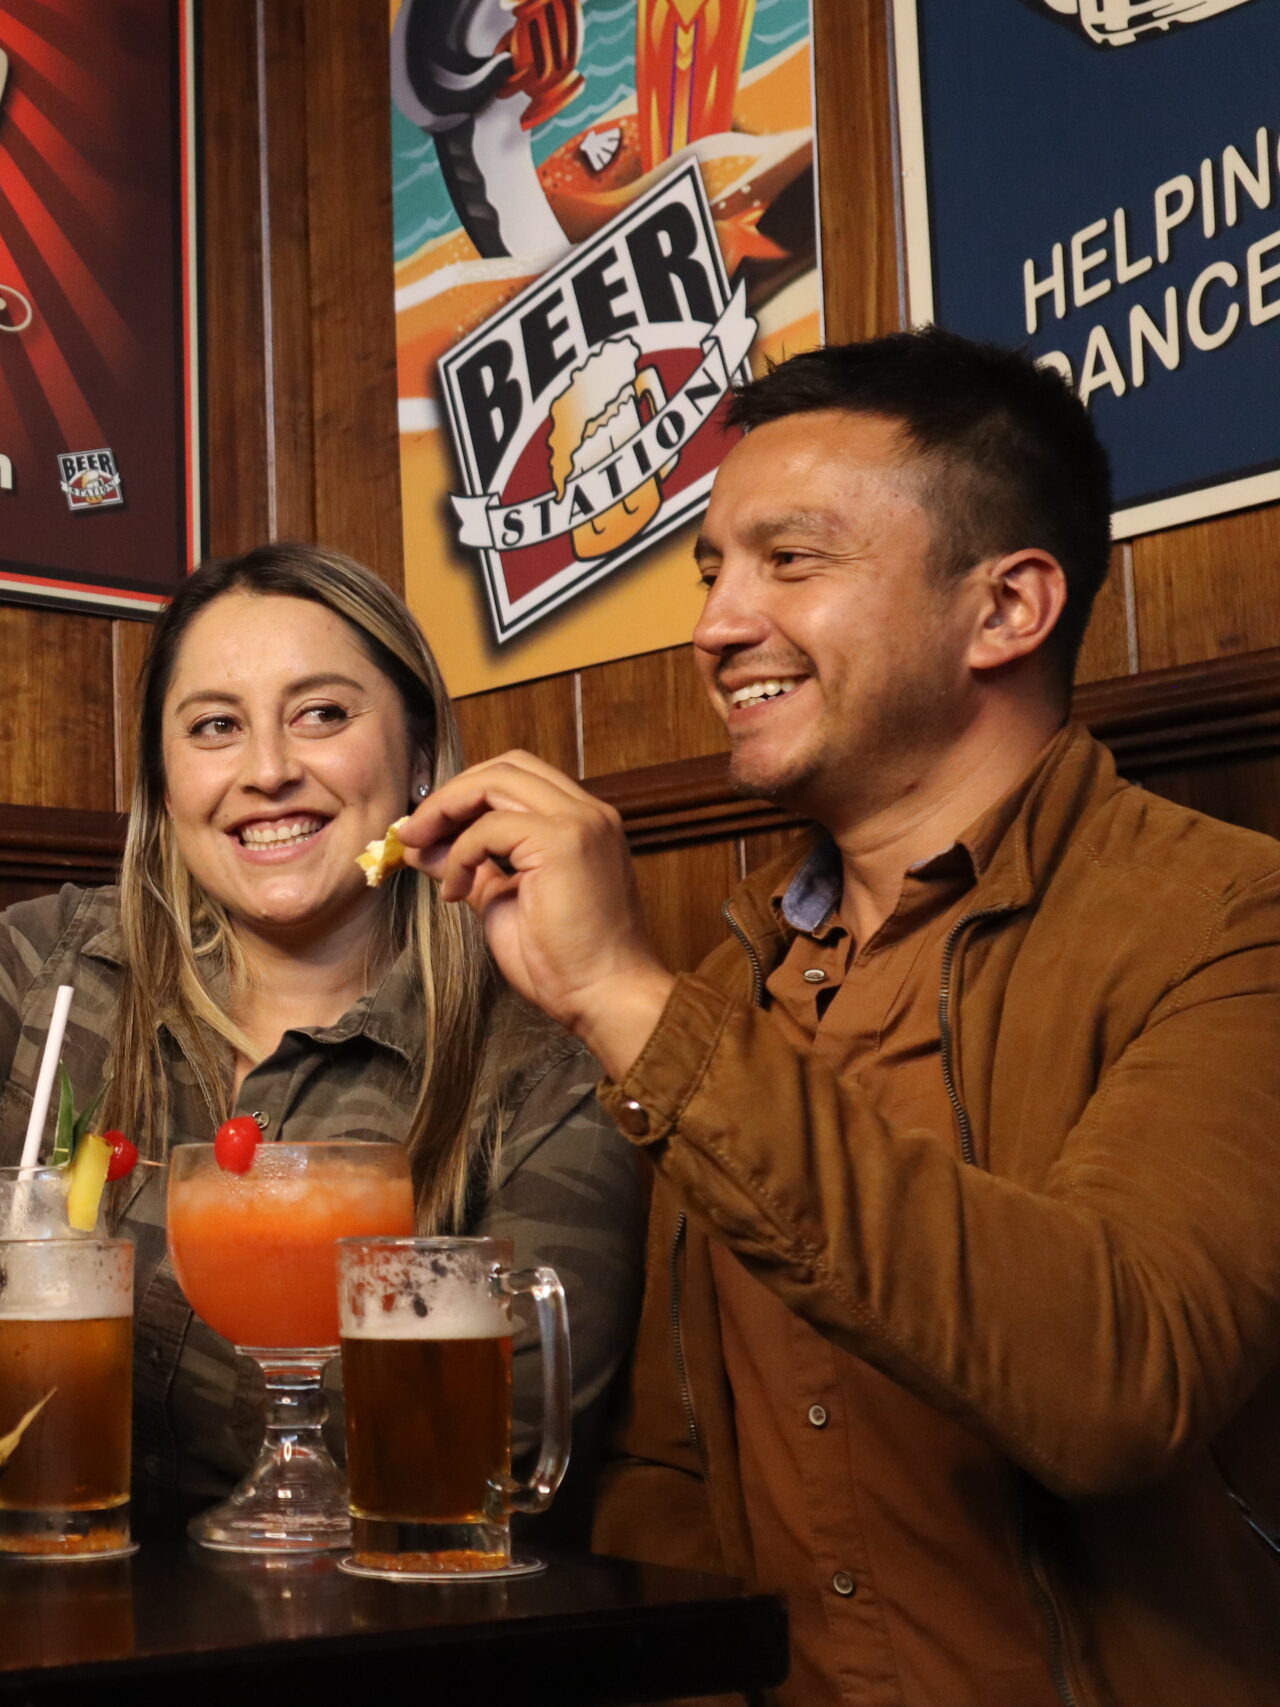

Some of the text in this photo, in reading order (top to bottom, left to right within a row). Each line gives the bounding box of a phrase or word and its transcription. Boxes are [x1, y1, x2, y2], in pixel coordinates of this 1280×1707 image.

[1023, 126, 1280, 335] HELPIN
[456, 201, 719, 493] BEER
[61, 453, 115, 482] BEER
[500, 365, 724, 547] STATION
